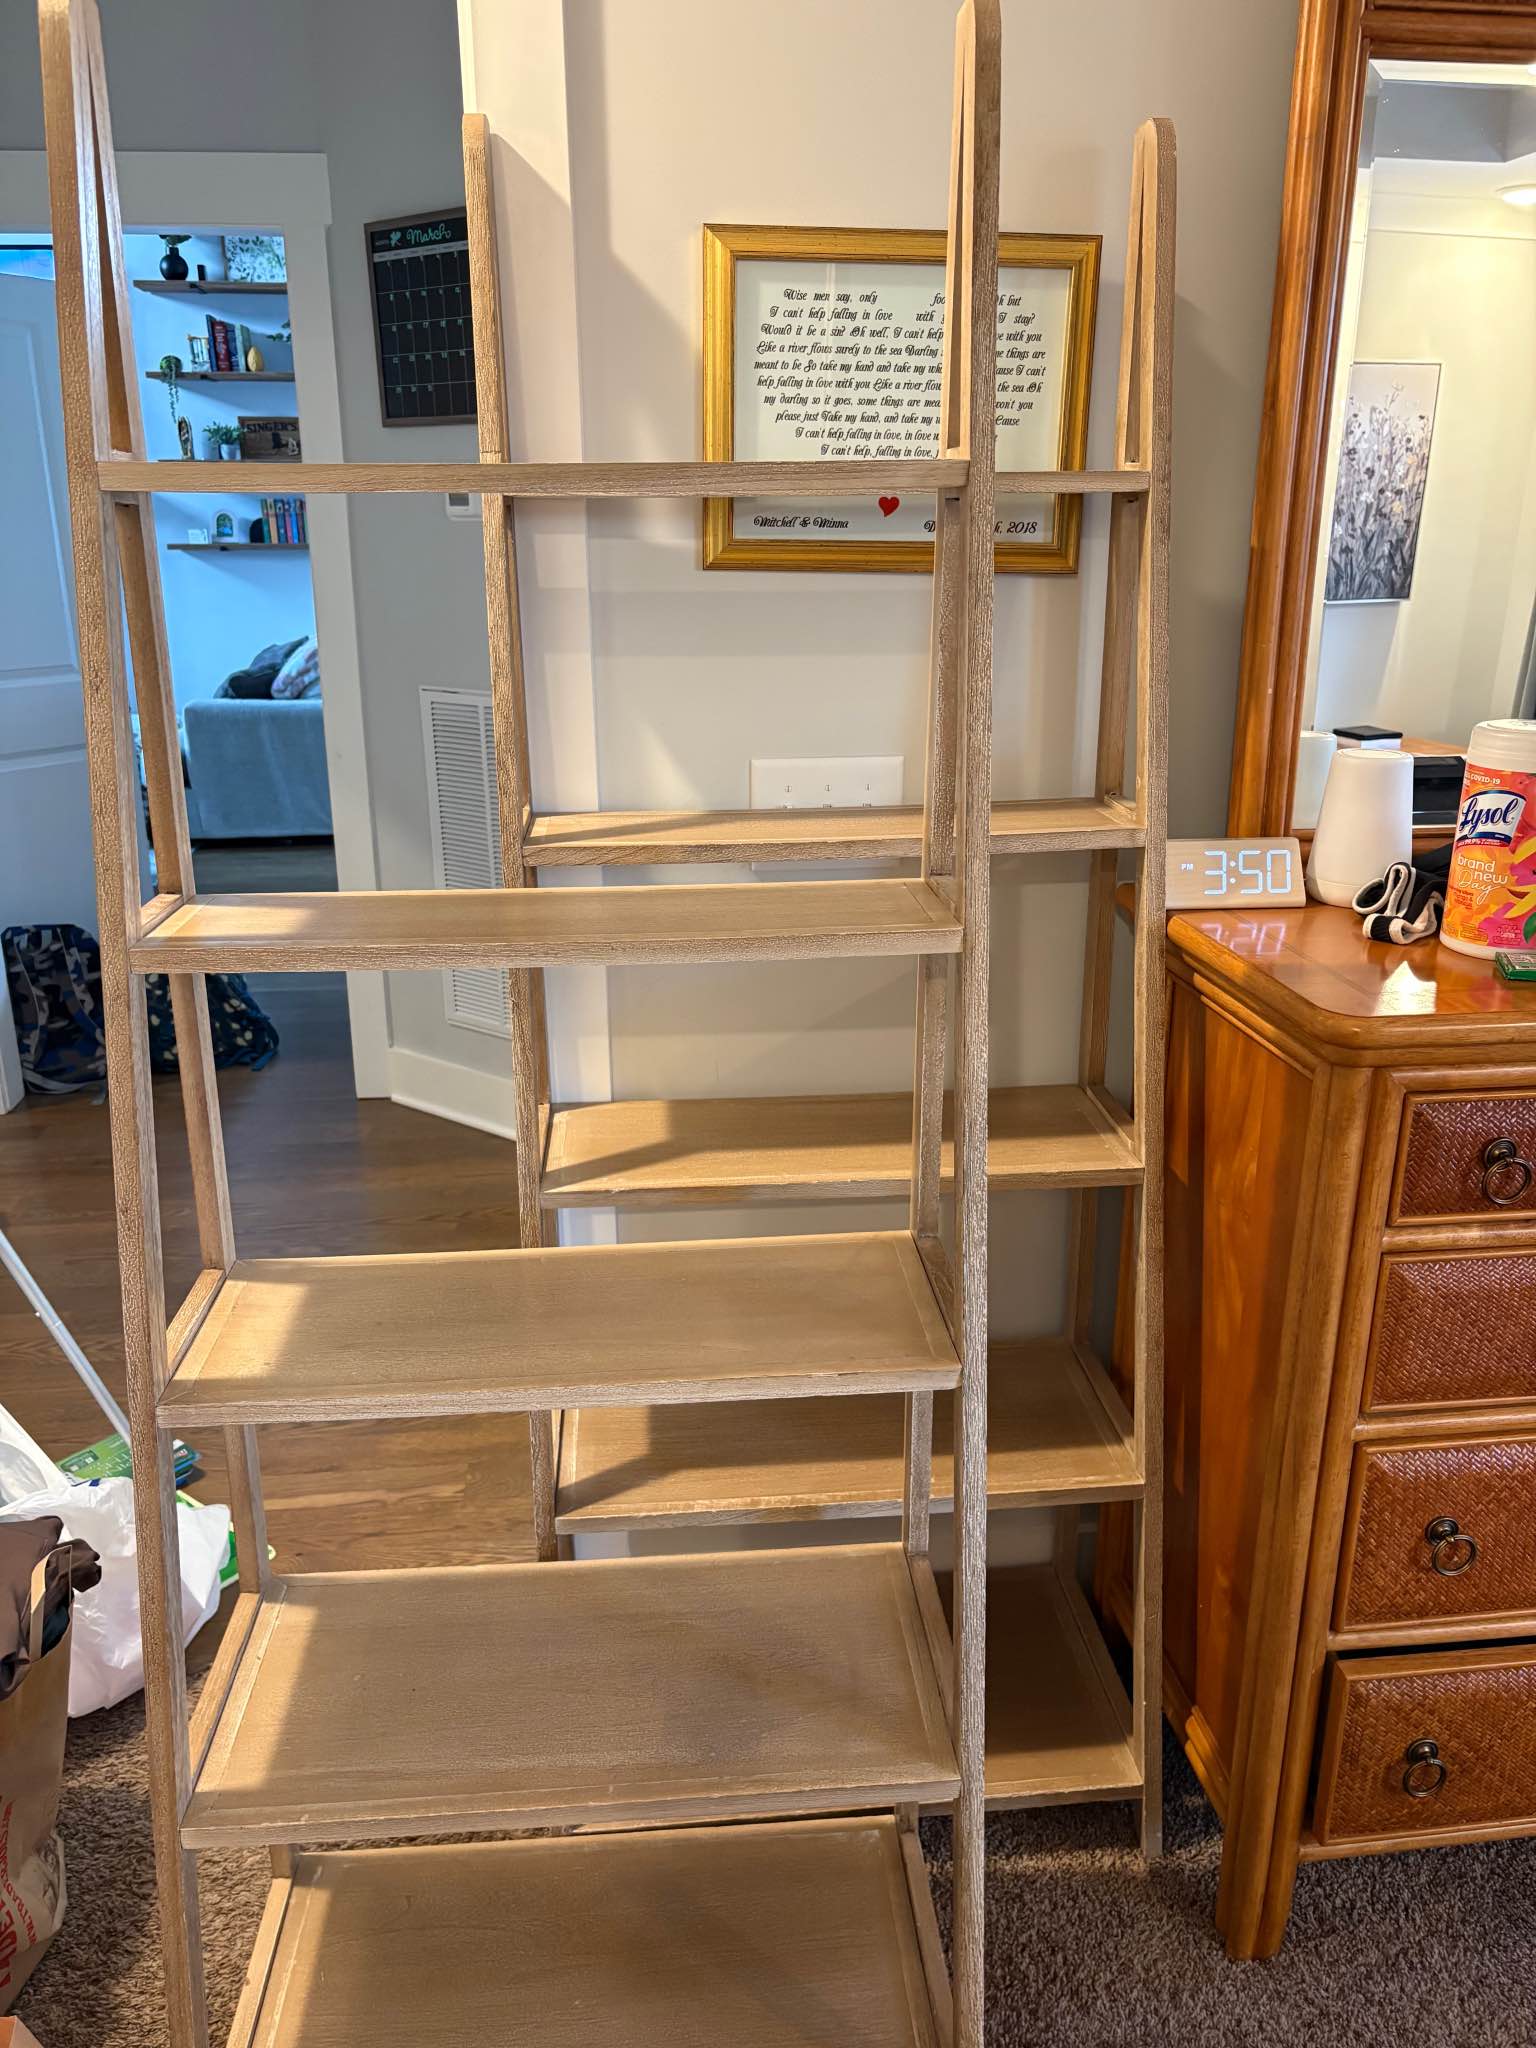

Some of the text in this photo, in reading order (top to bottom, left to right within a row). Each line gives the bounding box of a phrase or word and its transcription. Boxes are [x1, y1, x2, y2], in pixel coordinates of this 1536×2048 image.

[407, 223, 451, 244] March
[784, 289, 807, 301] Wise
[814, 293, 830, 301] men
[859, 291, 878, 304] only
[930, 293, 945, 306] foo
[1007, 295, 1021, 306] but
[783, 307, 803, 318] can't
[808, 307, 825, 321] help
[827, 308, 857, 321] falling
[862, 310, 870, 319] in
[875, 309, 893, 320] love
[916, 310, 936, 322] with
[1014, 313, 1035, 326] stay?
[761, 324, 792, 336] Would
[796, 325, 801, 335] it
[807, 324, 816, 336] be
[830, 327, 845, 337] sin?
[904, 328, 924, 339] can't
[1006, 331, 1025, 341] with
[1026, 334, 1042, 343] you
[779, 344, 785, 352] a
[788, 342, 807, 353] river
[807, 342, 832, 355] flows
[835, 342, 860, 356] surely
[864, 345, 871, 354] to
[874, 344, 887, 355] the
[889, 347, 902, 356] sea
[1006, 347, 1029, 360] things
[754, 360, 778, 370] meant
[781, 360, 789, 370] to
[792, 359, 802, 371] be
[819, 361, 837, 371] take
[840, 364, 852, 375] my
[854, 360, 874, 372] hand
[877, 362, 891, 372] and
[893, 362, 912, 373] take
[914, 366, 926, 375] my
[1026, 366, 1046, 377] can't
[757, 375, 774, 389] help
[774, 376, 803, 389] falling
[806, 377, 813, 387] in
[816, 376, 833, 388] love
[835, 377, 853, 388] with
[854, 380, 870, 390] you
[895, 381, 900, 389] a
[903, 380, 923, 390] river
[998, 382, 1010, 392] the
[764, 395, 776, 404] my
[780, 393, 808, 406] darling
[824, 395, 831, 405] it
[857, 397, 877, 406] some
[880, 395, 903, 408] things
[907, 399, 920, 407] are
[924, 399, 941, 407] mea
[1017, 401, 1033, 411] you
[775, 410, 802, 423] please
[801, 412, 819, 422] just
[845, 414, 857, 424] my
[884, 412, 898, 423] and
[901, 412, 919, 423] take
[921, 416, 934, 426] my
[805, 428, 825, 438] can't
[827, 428, 844, 441] help
[843, 428, 871, 442] falling
[874, 429, 881, 439] in
[905, 430, 912, 440] in
[914, 429, 932, 441] love
[831, 445, 851, 456] can't
[873, 446, 902, 458] falling
[904, 446, 912, 457] in
[753, 515, 798, 528] Mitchell
[1007, 522, 1037, 534] 2018
[1471, 773, 1501, 785] COVID-19
[1459, 798, 1518, 834] Lysol
[1204, 850, 1291, 895] 3:50
[1457, 856, 1496, 872] brand
[1474, 871, 1508, 884] new
[1458, 869, 1501, 905] Day
